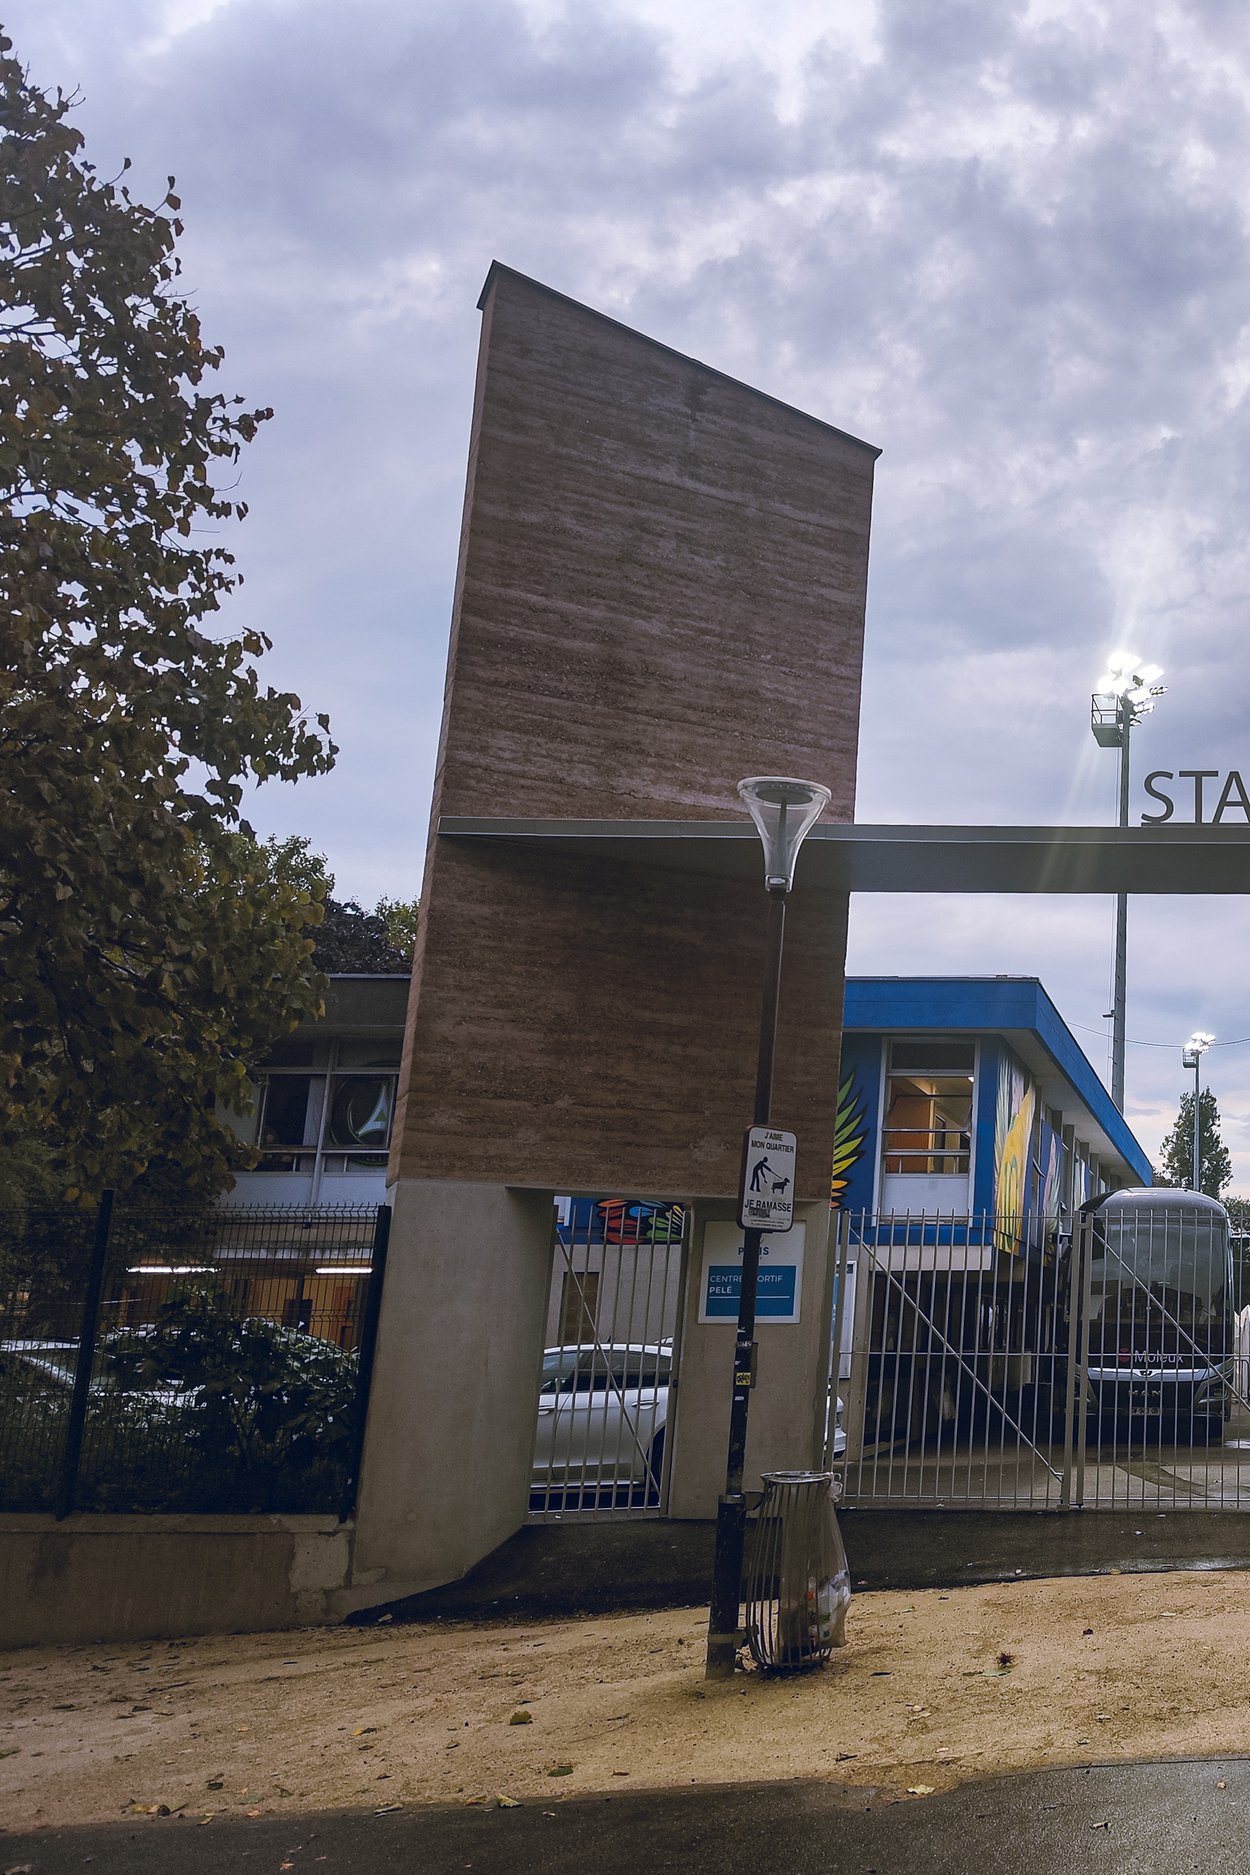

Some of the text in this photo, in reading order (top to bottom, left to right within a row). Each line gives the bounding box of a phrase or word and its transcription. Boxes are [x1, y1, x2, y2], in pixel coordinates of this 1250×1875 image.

[751, 1139, 795, 1153] MON QUARTIER
[744, 1199, 755, 1209] JE
[756, 1200, 792, 1213] RAMASSE
[738, 1246, 770, 1256] PIS
[752, 1275, 783, 1283] ORTIF
[709, 1285, 732, 1294] PELÉ
[1134, 1349, 1184, 1363] Moleux
